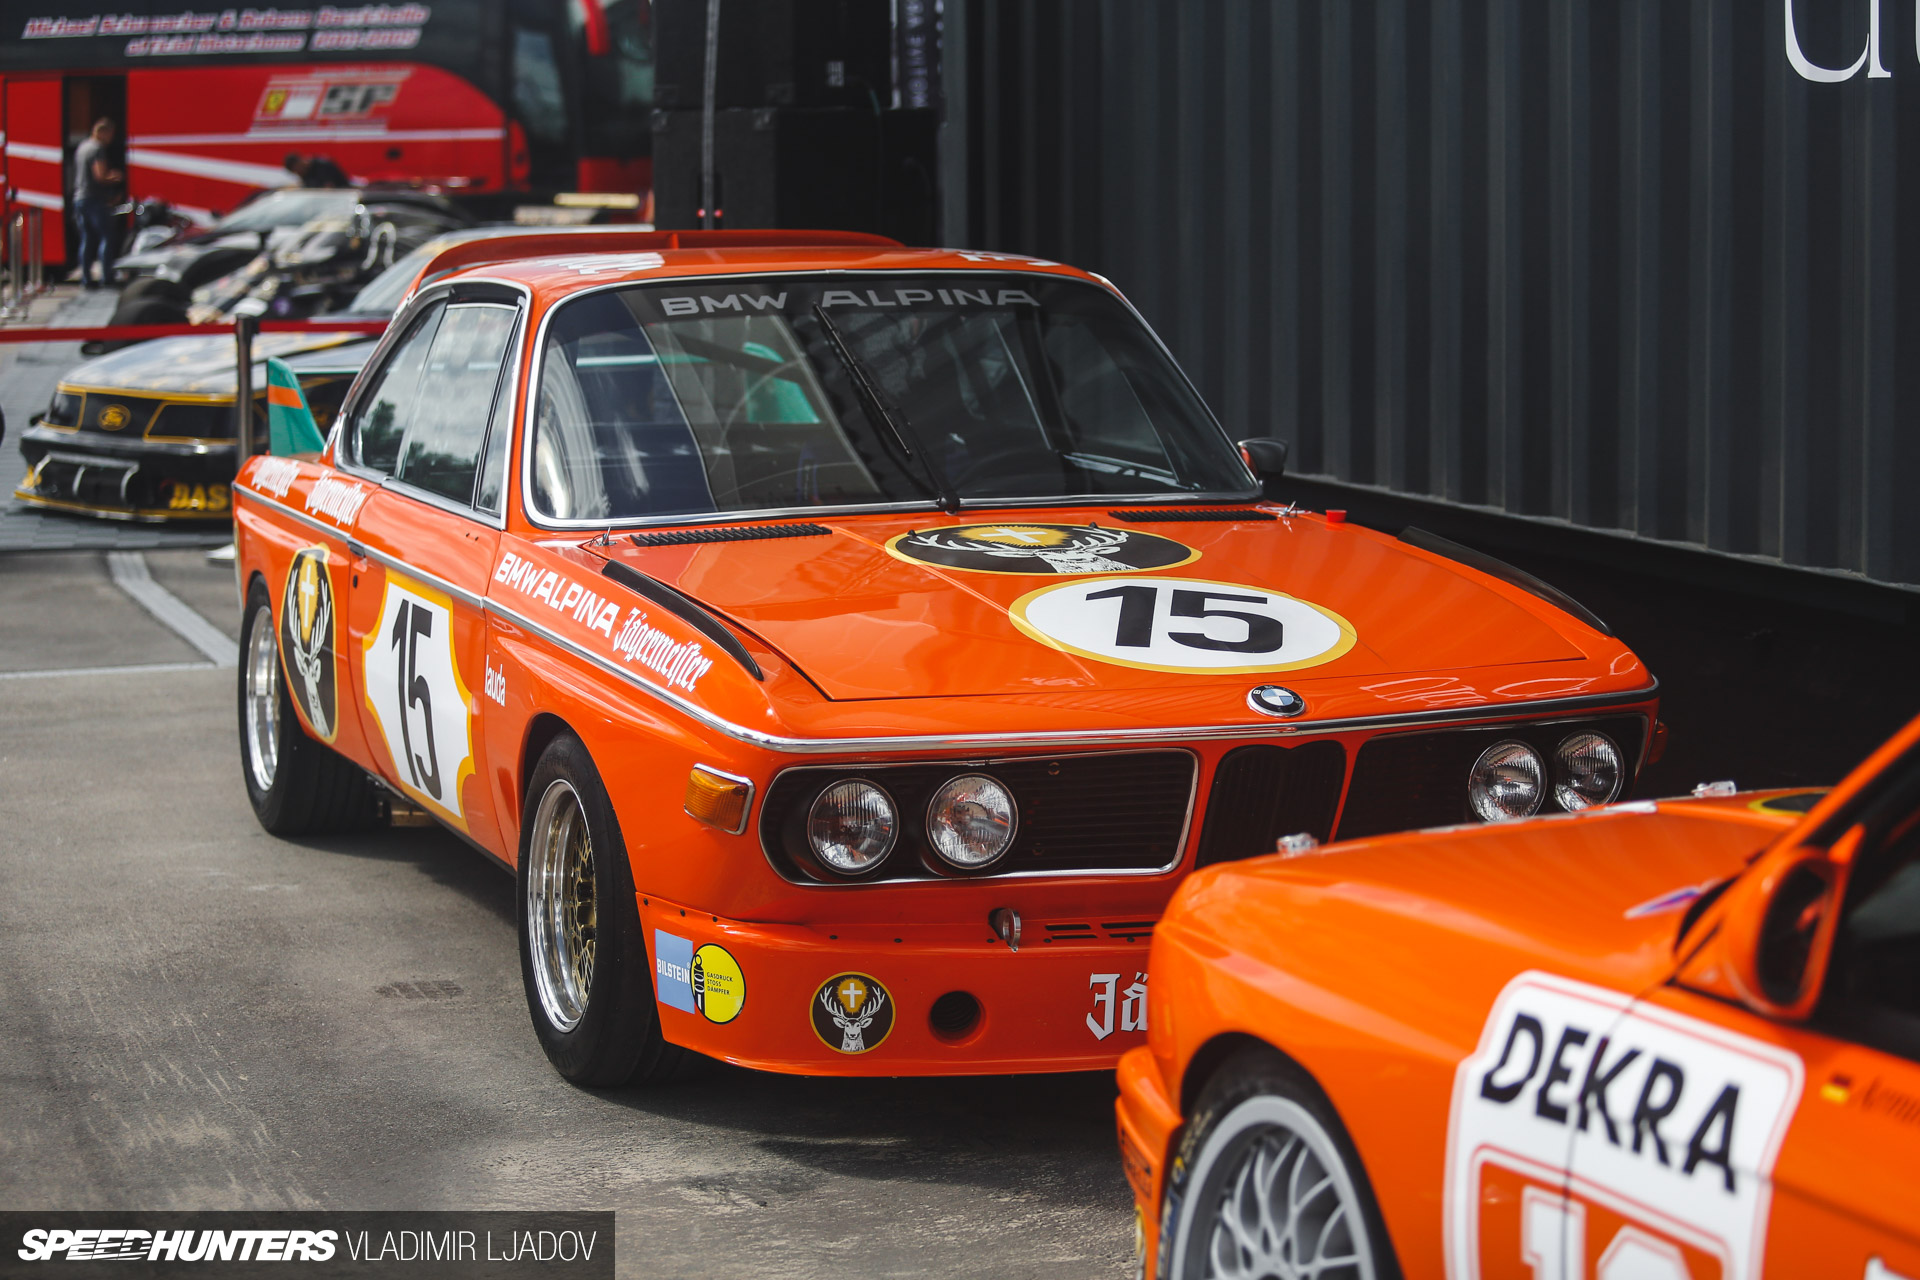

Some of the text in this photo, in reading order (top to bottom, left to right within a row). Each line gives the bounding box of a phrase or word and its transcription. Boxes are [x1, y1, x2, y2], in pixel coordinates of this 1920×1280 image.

[660, 289, 1041, 316] BMW ALPINA
[1085, 585, 1283, 653] 15
[392, 598, 442, 801] 15
[656, 957, 691, 984] BILSTEIN
[1480, 1013, 1739, 1194] DEKRA
